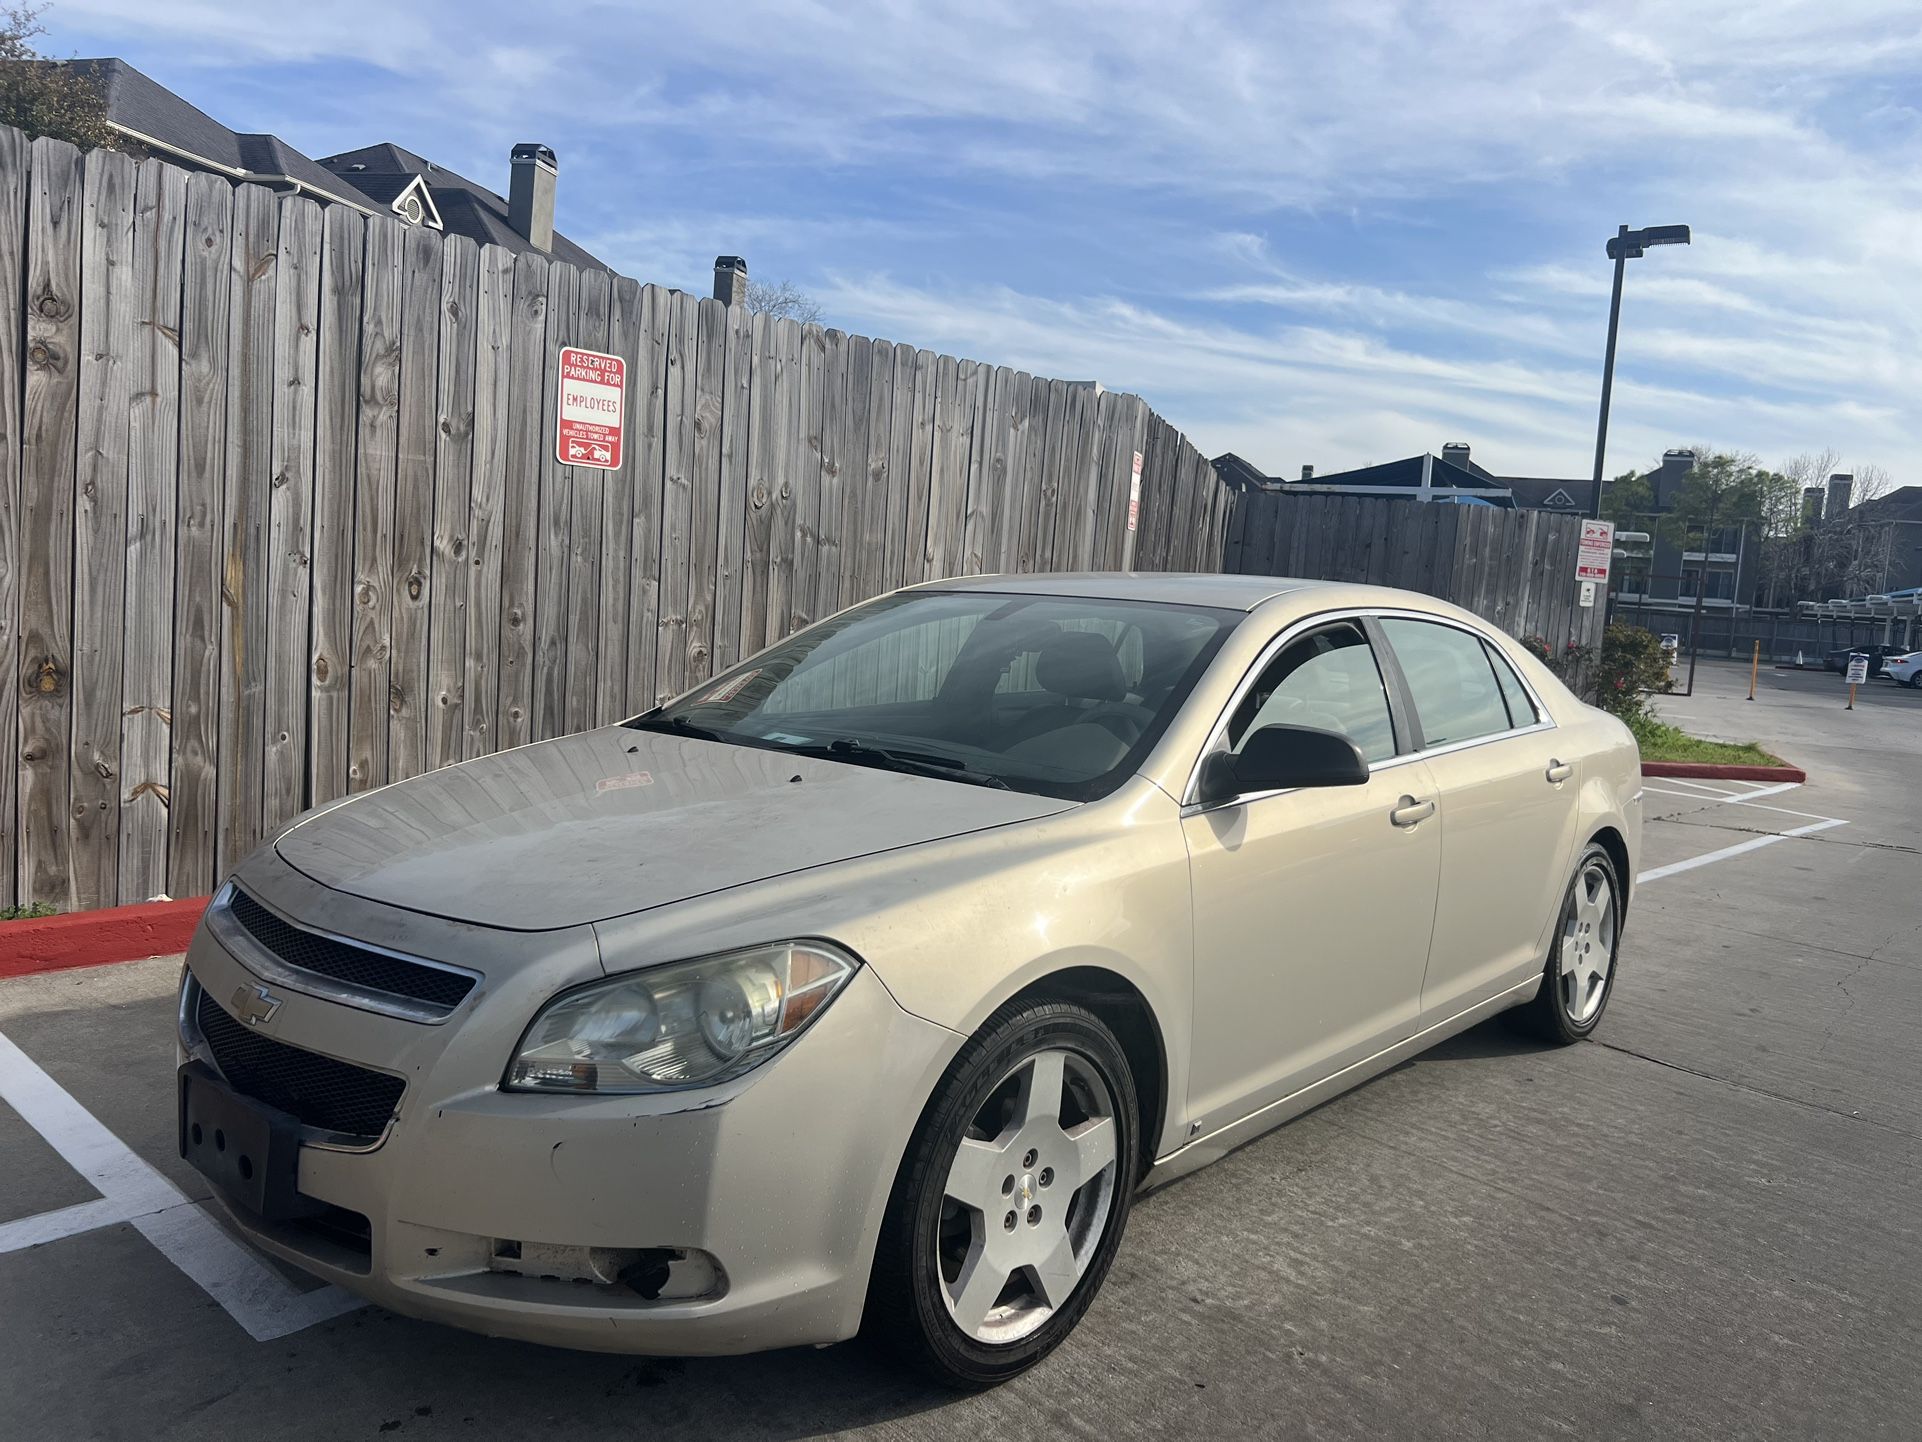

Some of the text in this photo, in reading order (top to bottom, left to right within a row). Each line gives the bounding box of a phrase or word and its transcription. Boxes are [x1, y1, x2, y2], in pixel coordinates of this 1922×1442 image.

[570, 353, 618, 372] RESERVED
[564, 365, 621, 385] PARKING FOR
[566, 393, 617, 413] EMPLOYEES
[563, 428, 618, 443] VEHICLES TOWED AWAY
[572, 423, 609, 434] UNAUTHORIZED
